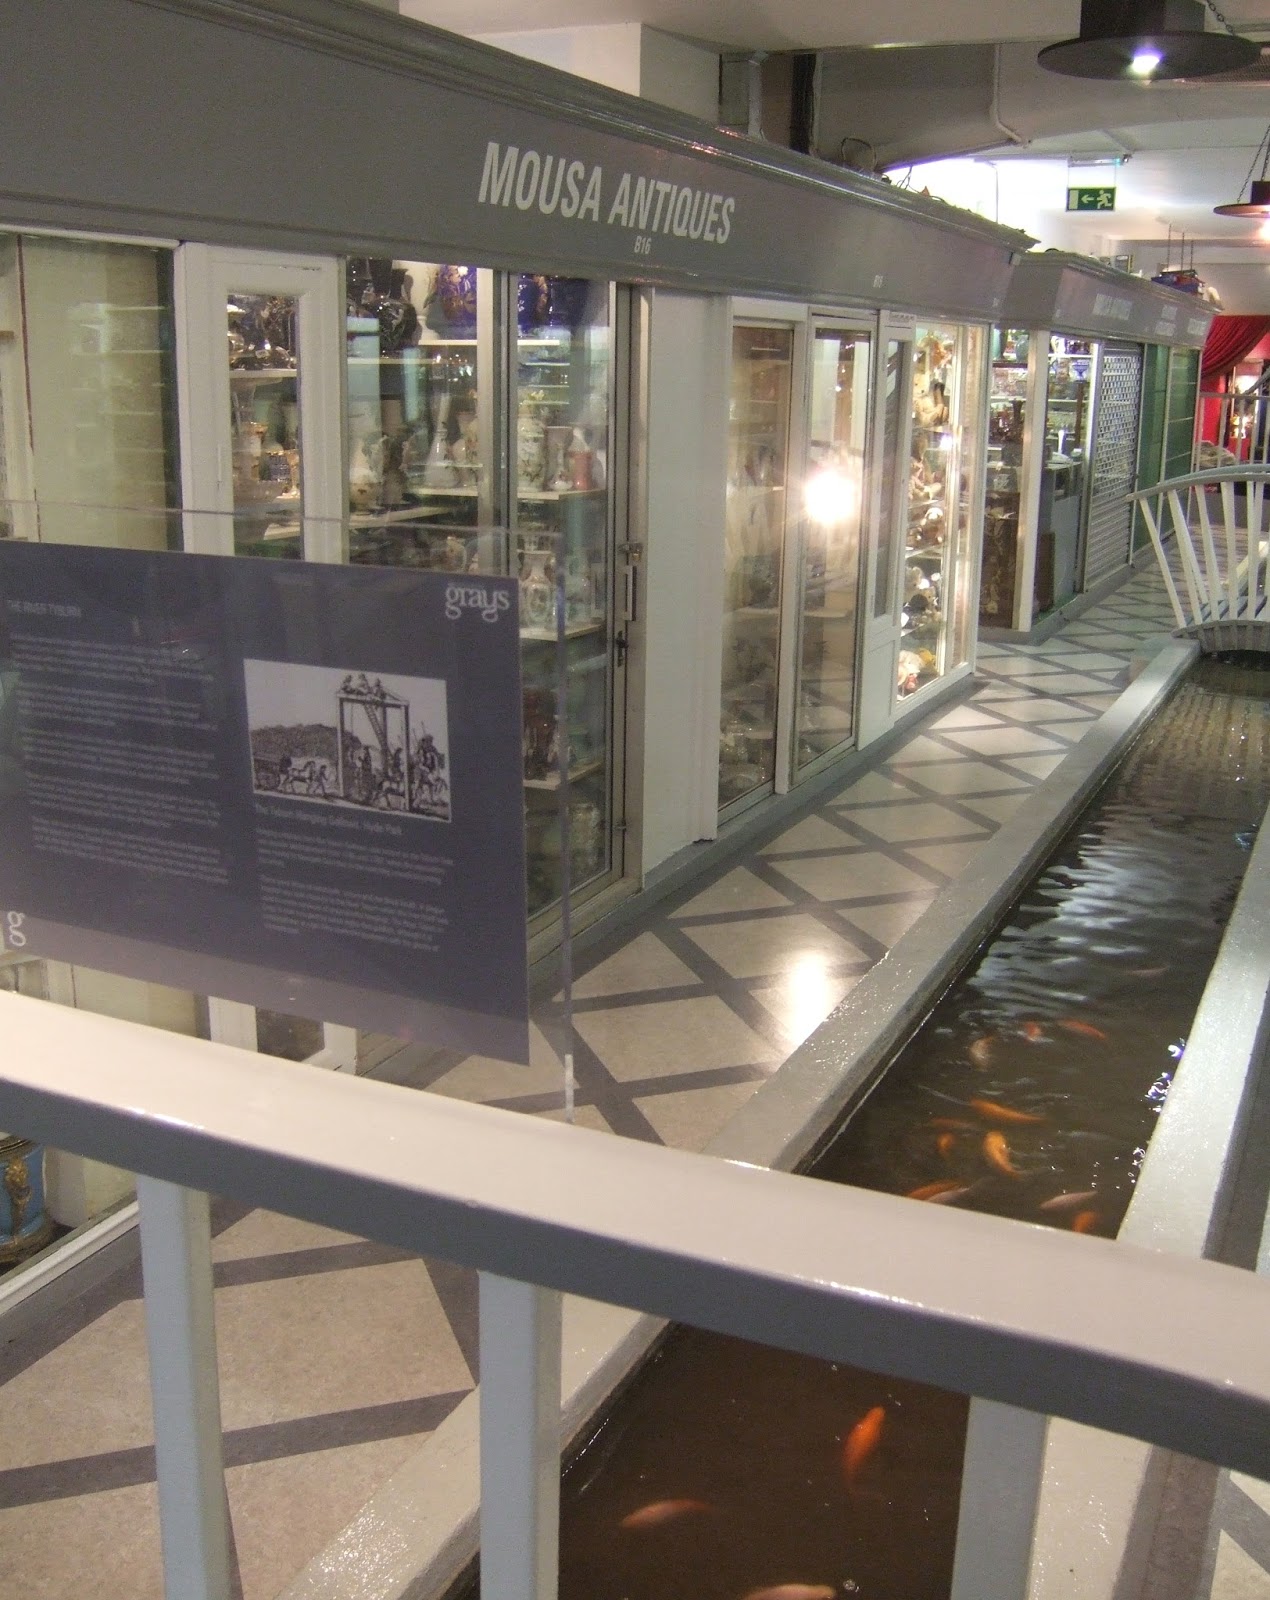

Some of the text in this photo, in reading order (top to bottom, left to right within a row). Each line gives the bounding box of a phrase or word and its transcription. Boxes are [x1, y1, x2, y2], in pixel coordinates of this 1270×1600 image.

[478, 142, 735, 244] MOUSA ANTIQUES
[634, 235, 651, 255] B16
[445, 585, 509, 622] grays
